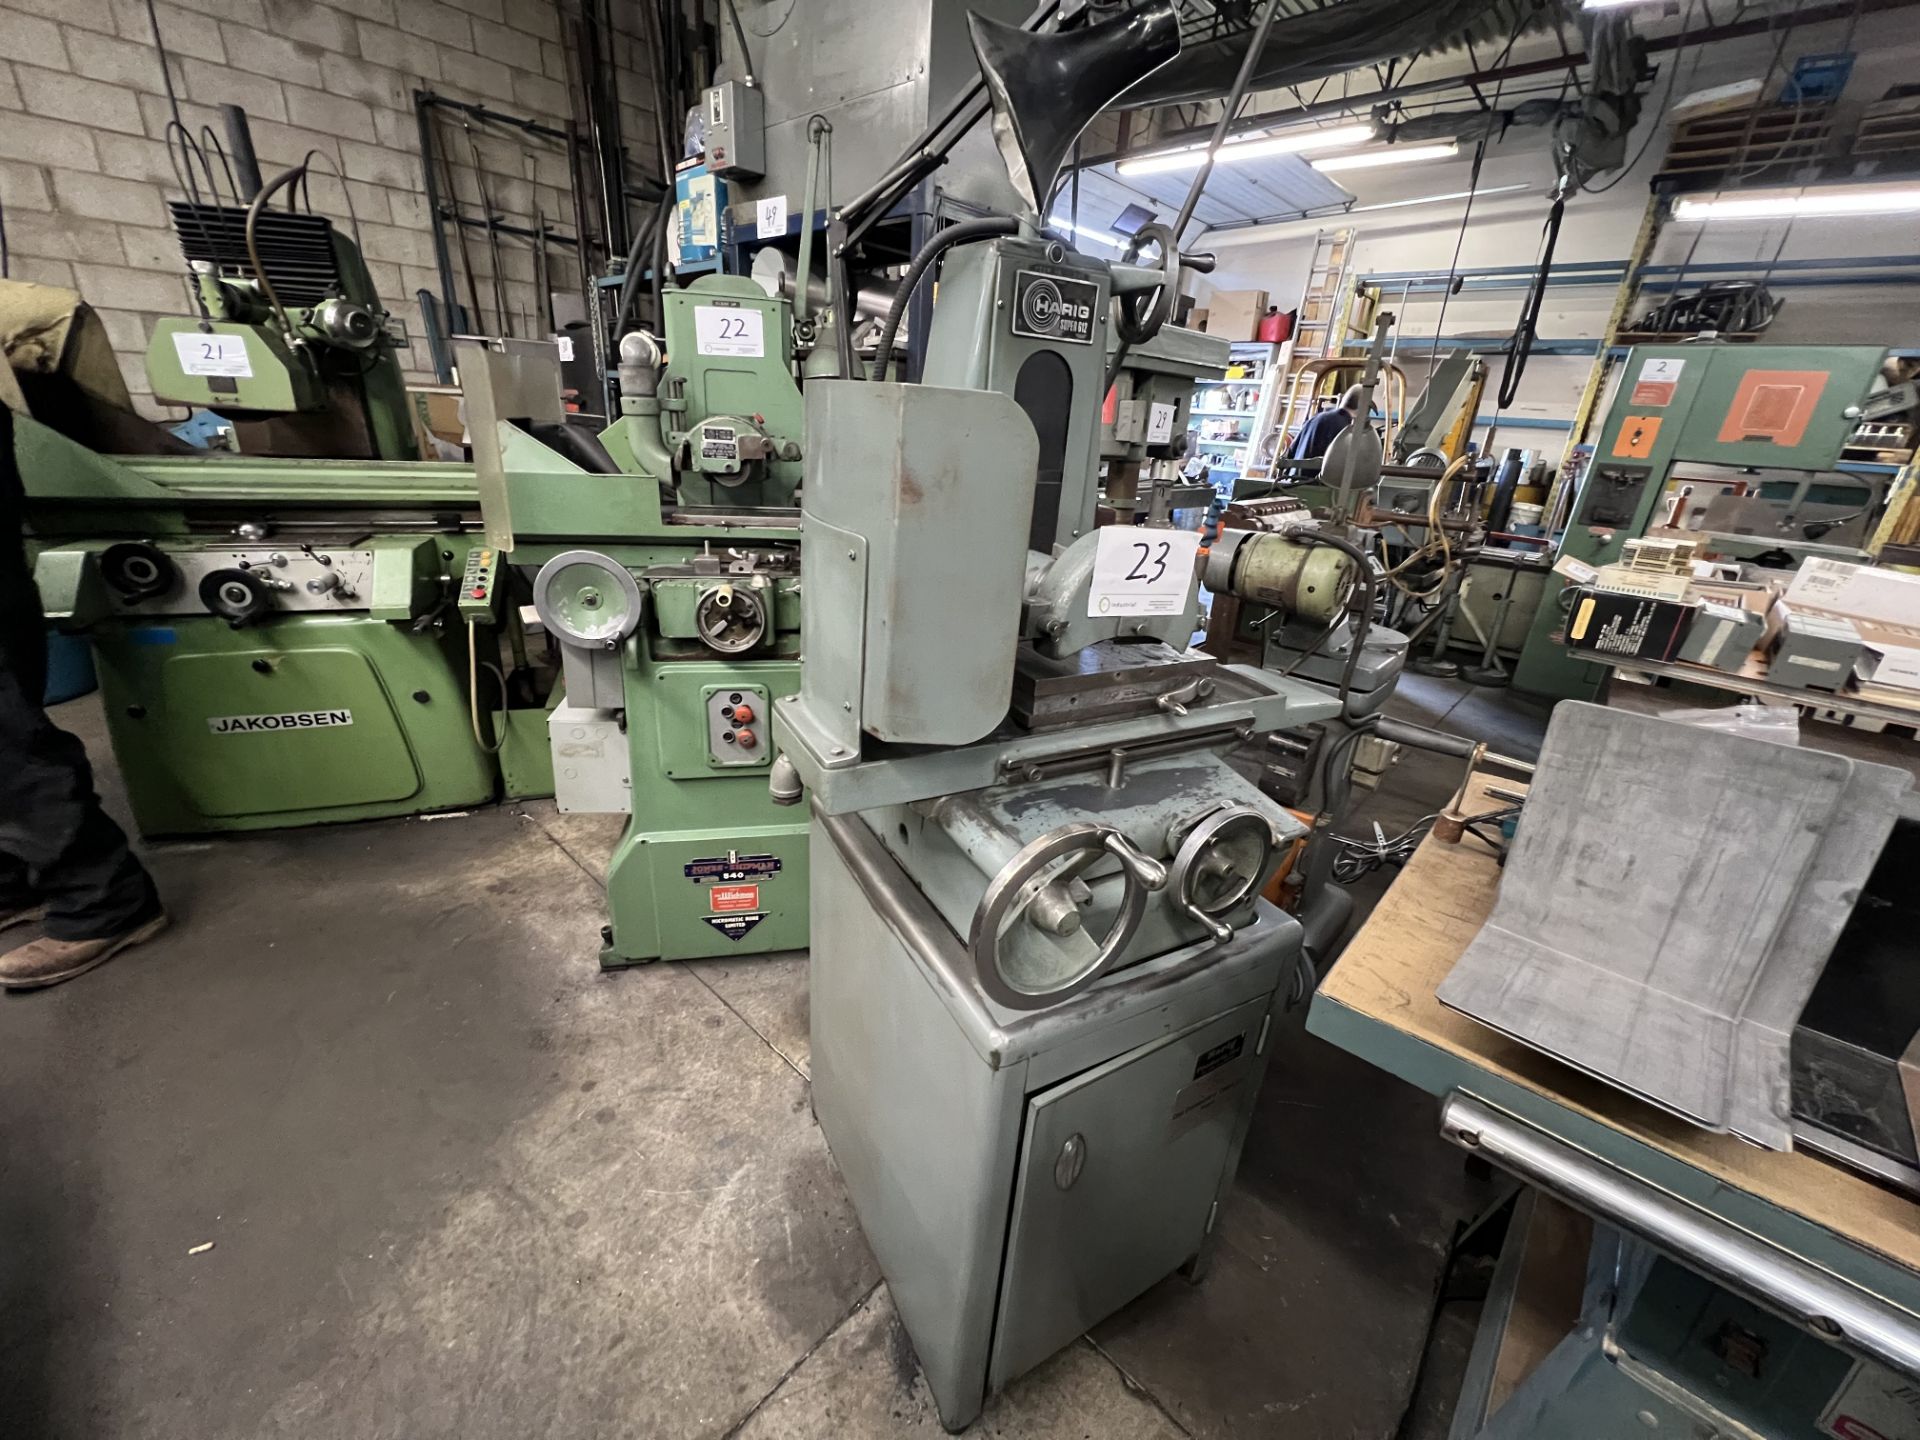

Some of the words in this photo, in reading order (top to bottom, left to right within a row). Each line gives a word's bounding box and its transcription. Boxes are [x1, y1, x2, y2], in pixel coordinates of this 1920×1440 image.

[765, 206, 777, 227] 49
[1036, 299, 1090, 319] HARIG
[719, 318, 749, 339] 22
[1060, 319, 1078, 332] SUPER
[1078, 321, 1088, 334] 612
[201, 343, 222, 360] 21
[1657, 361, 1667, 373] 2
[1155, 410, 1168, 429] 29
[1125, 541, 1171, 584] 23
[216, 711, 347, 732] JAKOBSEN
[723, 872, 744, 880] 540
